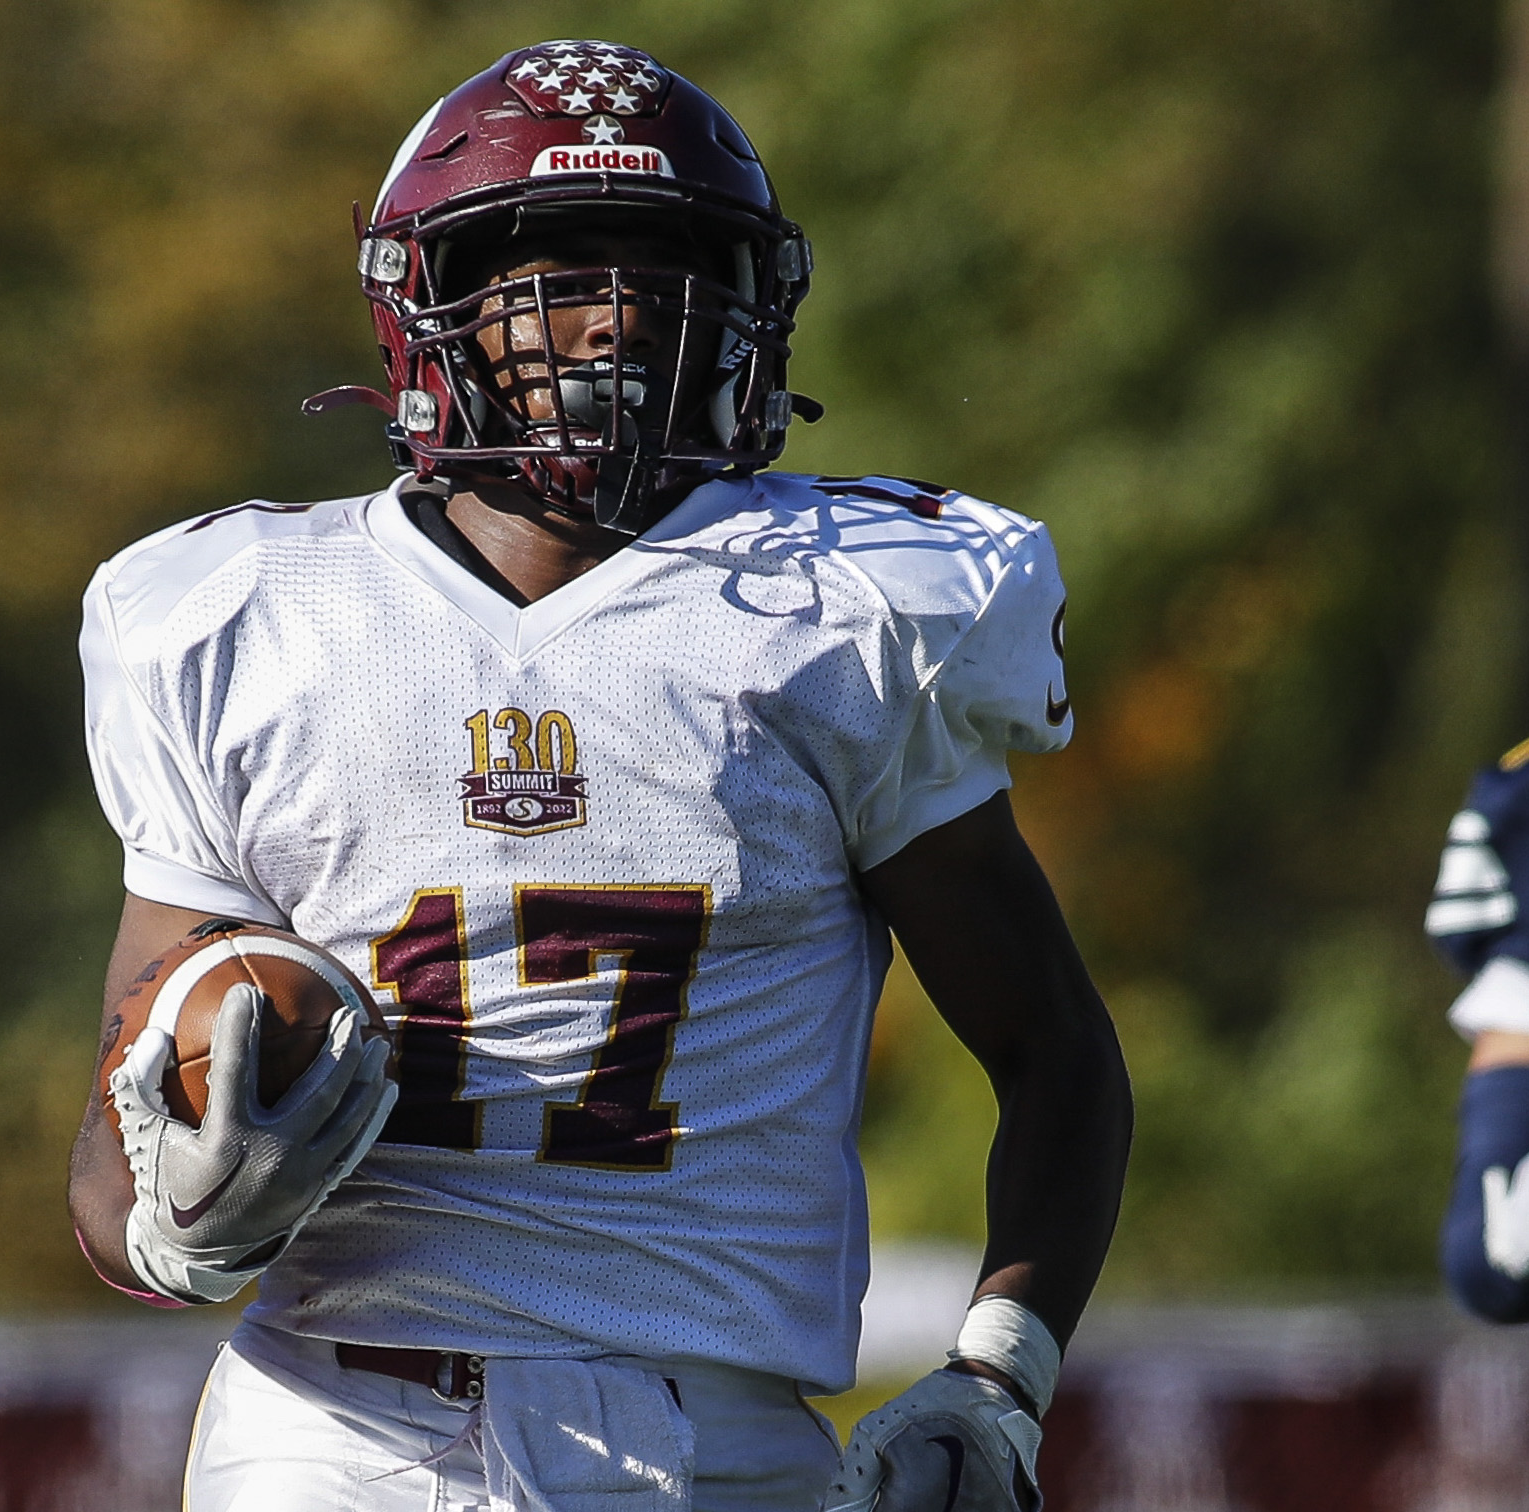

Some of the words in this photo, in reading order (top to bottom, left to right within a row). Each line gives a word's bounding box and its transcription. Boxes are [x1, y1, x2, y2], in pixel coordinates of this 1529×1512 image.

[549, 149, 660, 172] Riddell
[463, 707, 579, 776] 130
[490, 773, 554, 791] SUMMIT
[476, 803, 502, 815] 1892
[370, 882, 713, 1172] 17
